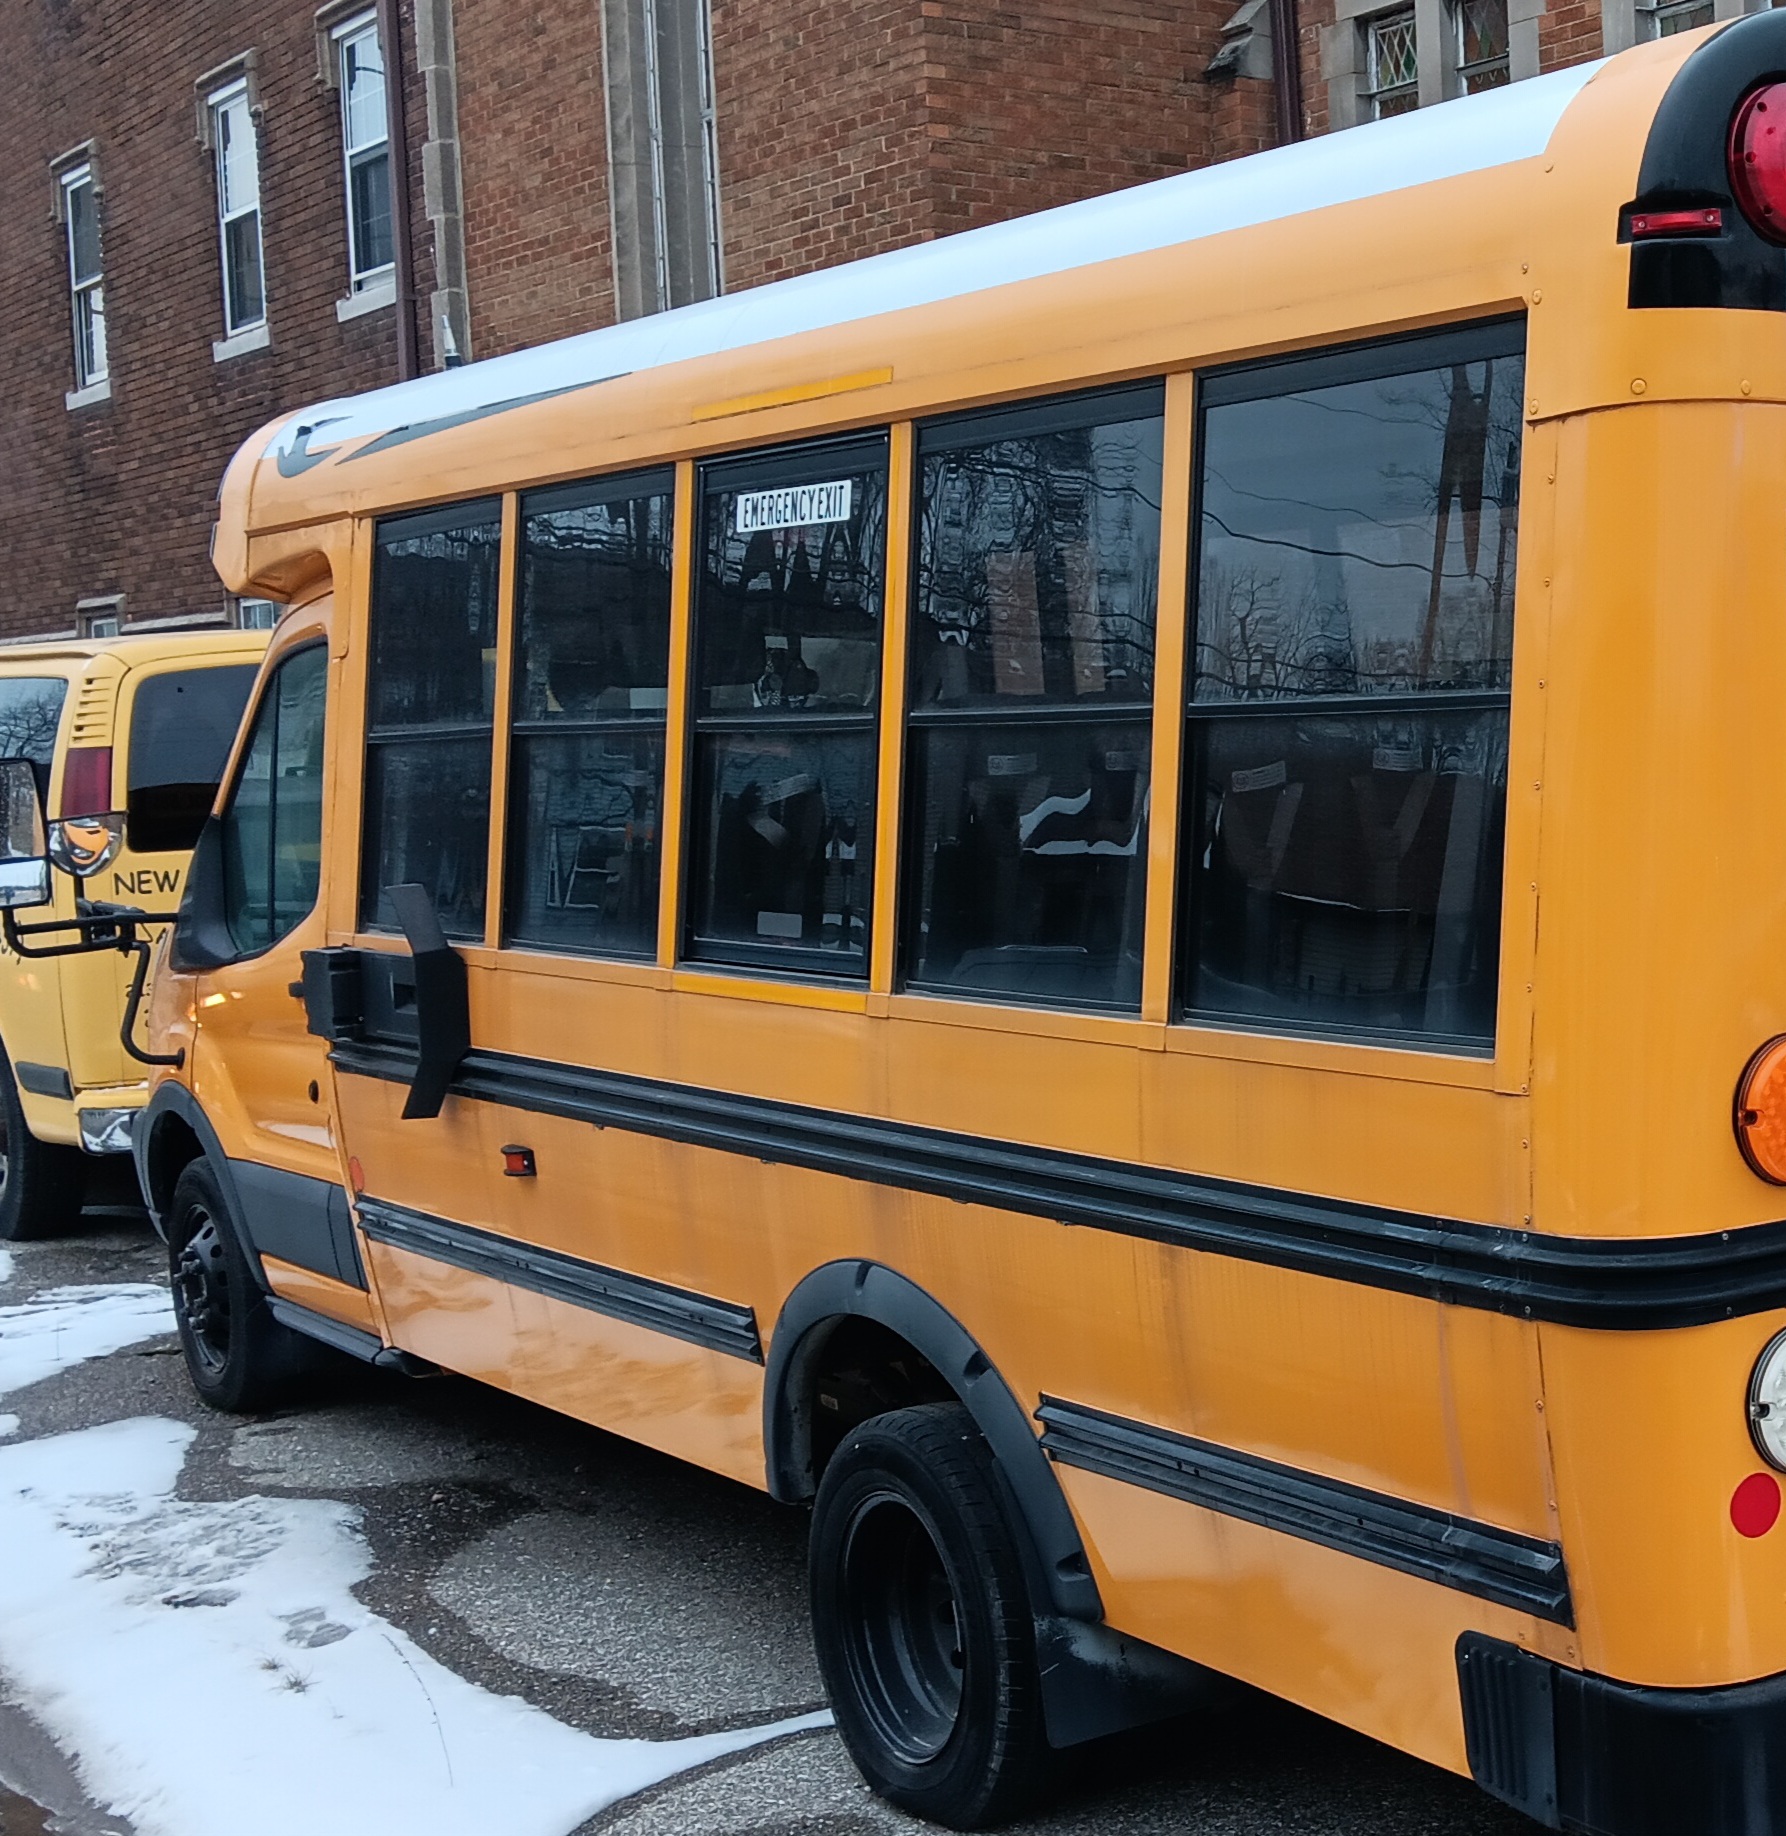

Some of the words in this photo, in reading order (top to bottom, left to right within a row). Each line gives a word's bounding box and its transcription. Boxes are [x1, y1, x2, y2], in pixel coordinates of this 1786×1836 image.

[743, 487, 816, 528] EMERGENCY
[817, 484, 845, 519] EXIT
[113, 869, 180, 896] NEW
